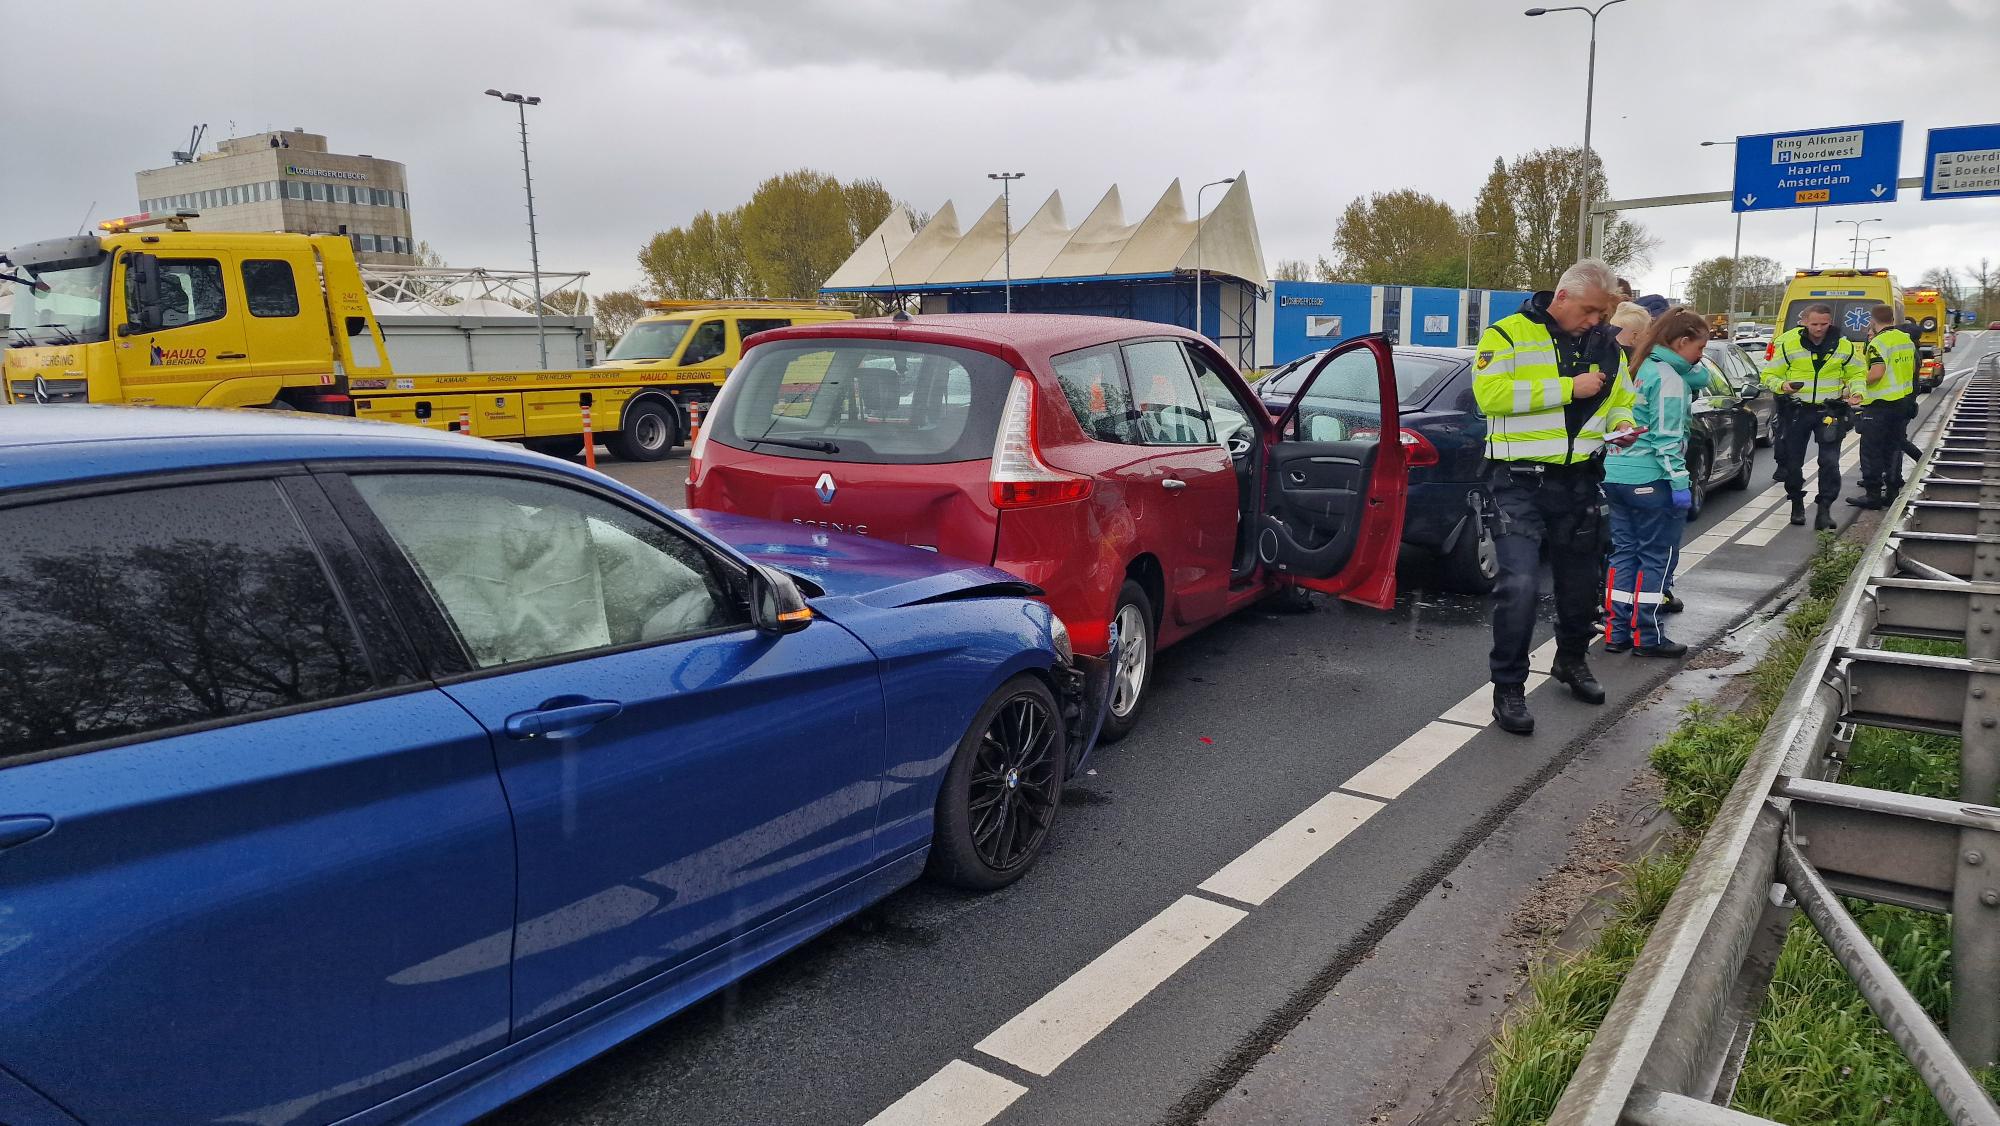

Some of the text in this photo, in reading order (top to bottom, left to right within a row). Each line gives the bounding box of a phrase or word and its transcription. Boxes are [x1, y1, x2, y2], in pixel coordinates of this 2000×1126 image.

[1776, 133, 1859, 149] Ring Alkmaar
[1793, 147, 1854, 160] Noordwest
[1788, 163, 1842, 176] Haarlem
[1777, 174, 1850, 189] Amsterdam
[1798, 192, 1827, 201] N242
[41, 354, 74, 366] BERGING
[161, 348, 207, 360] HAULO
[166, 357, 206, 366] BERGING
[487, 375, 518, 383] SCHAGEN
[640, 371, 711, 381] HAULO BERGING
